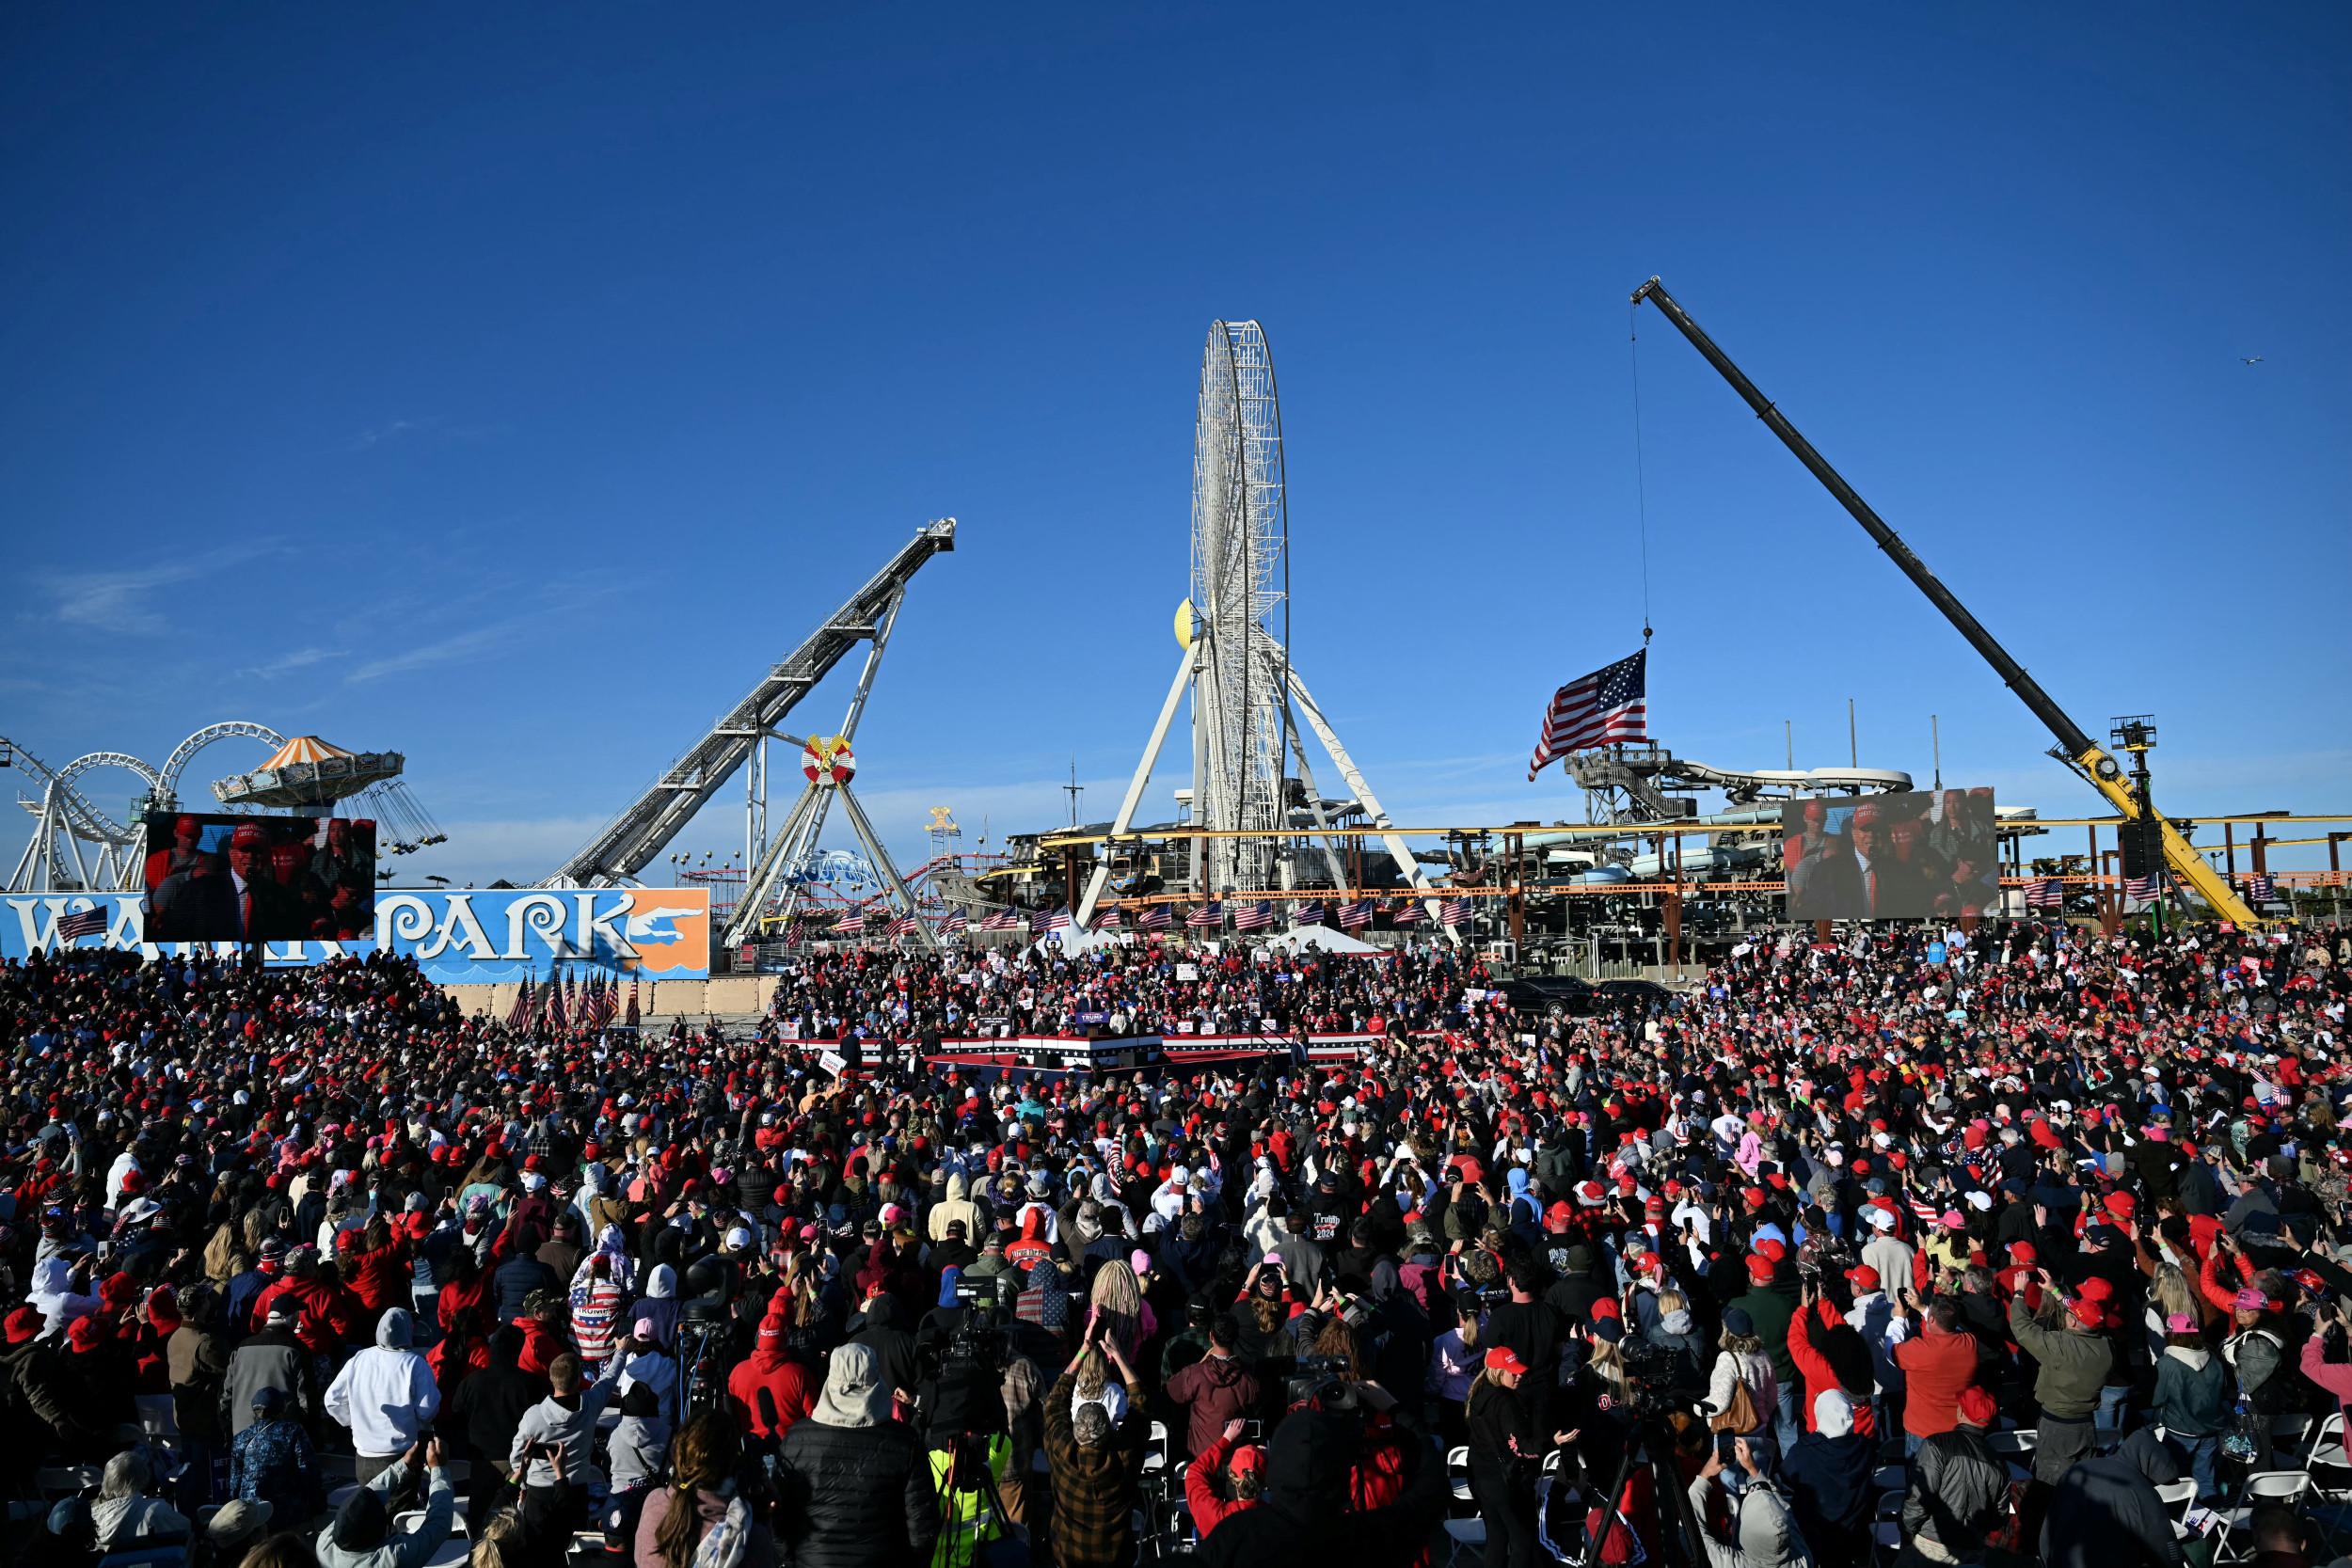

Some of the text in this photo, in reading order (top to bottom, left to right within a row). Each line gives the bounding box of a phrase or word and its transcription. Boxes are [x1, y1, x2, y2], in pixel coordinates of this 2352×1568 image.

[374, 894, 642, 959] PARK
[1313, 1212, 1341, 1225] Trump
[1317, 1229, 1335, 1239] 2024
